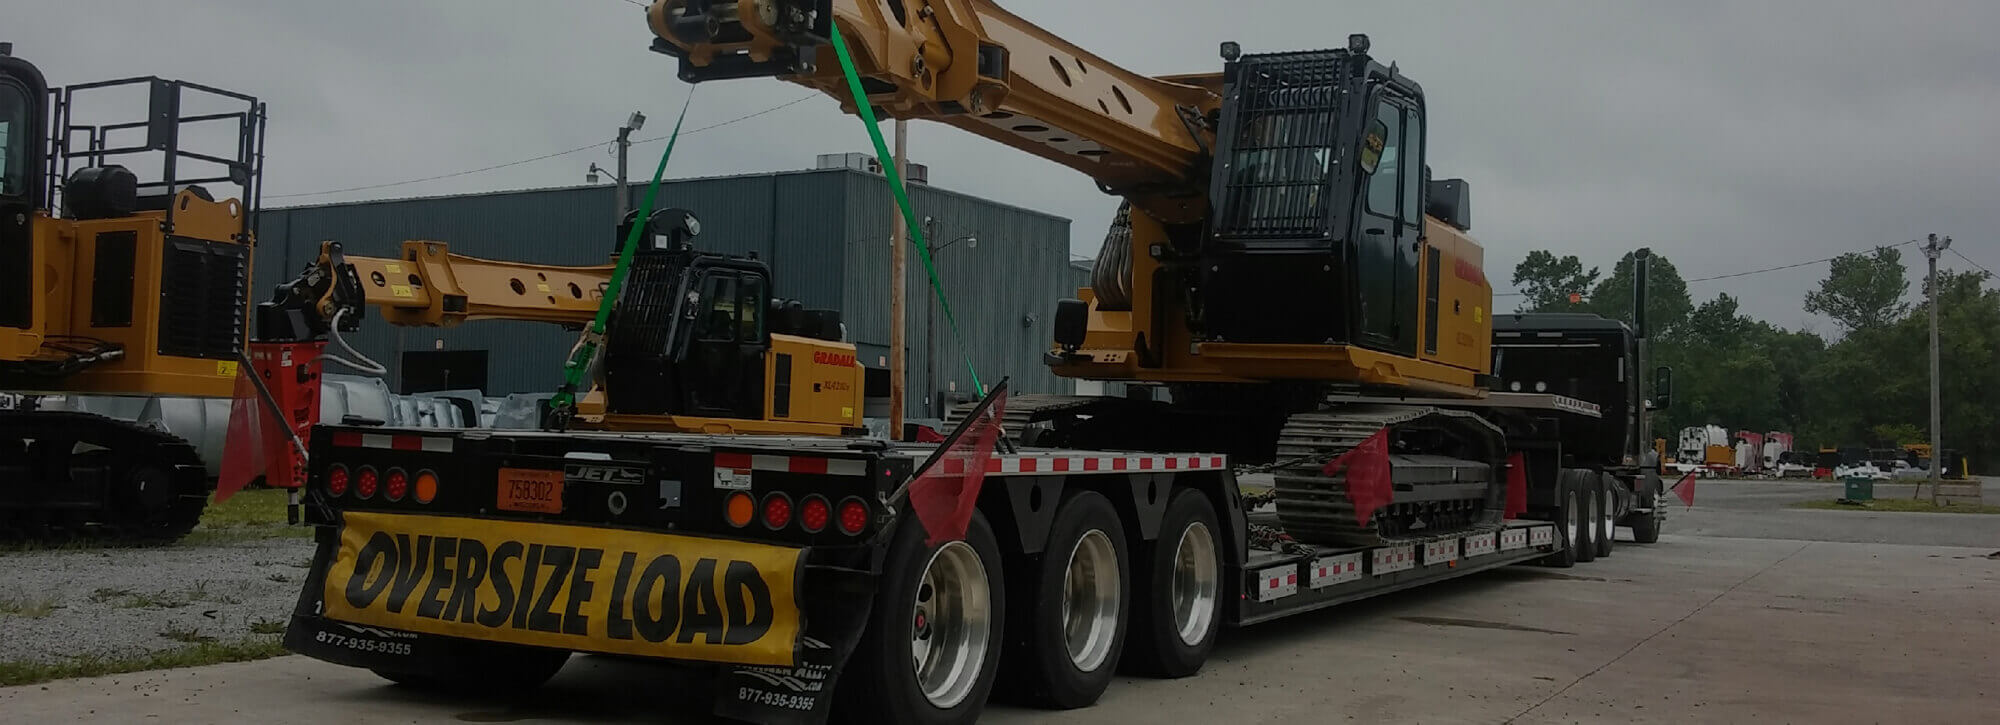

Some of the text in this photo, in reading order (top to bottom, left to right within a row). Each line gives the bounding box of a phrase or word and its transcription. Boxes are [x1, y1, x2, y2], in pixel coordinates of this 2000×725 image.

[566, 466, 619, 481] JET
[344, 530, 774, 645] OVERSIZE LOAD
[315, 630, 412, 656] 877-935-9355
[738, 687, 815, 711] 877-935-9355
